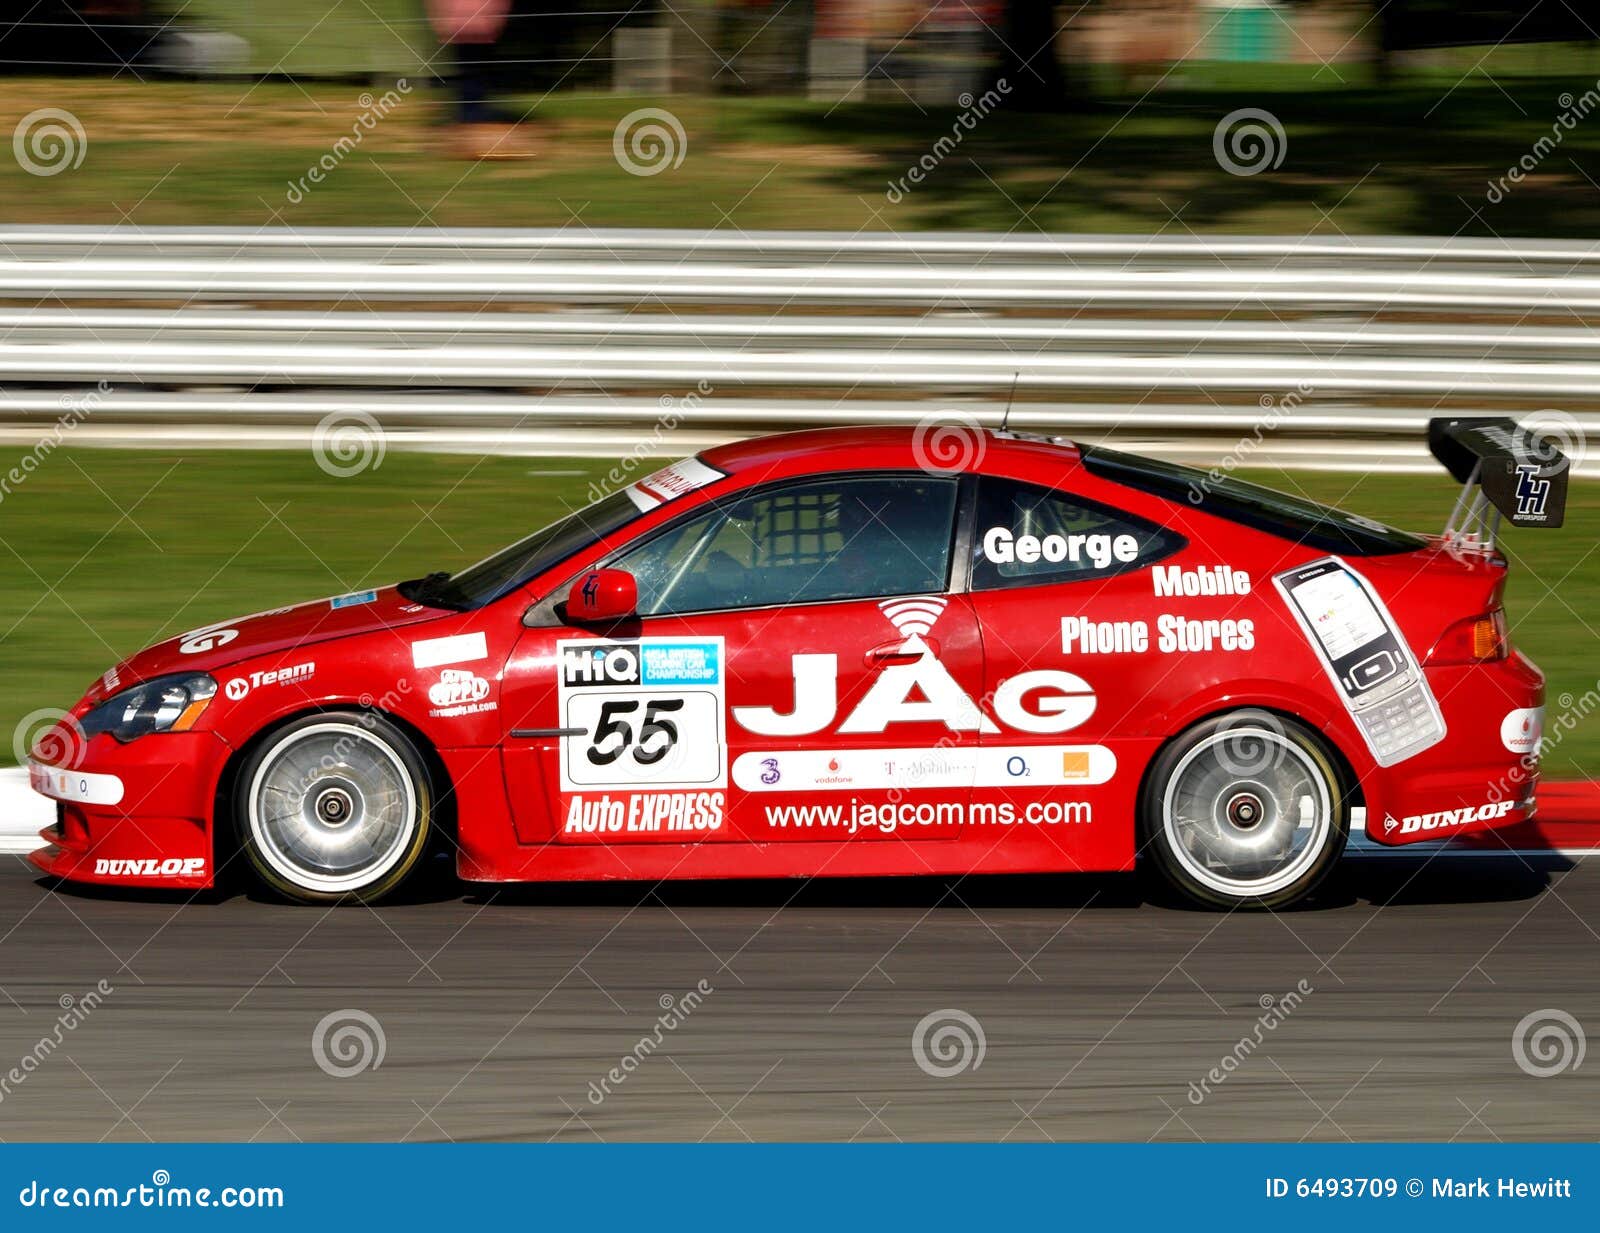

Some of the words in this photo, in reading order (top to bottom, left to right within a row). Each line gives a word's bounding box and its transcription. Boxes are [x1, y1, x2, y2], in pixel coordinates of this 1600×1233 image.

[983, 527, 1139, 568] George
[1151, 565, 1251, 597] Mobile
[1060, 616, 1149, 654] Phone
[1157, 614, 1255, 653] Stores
[250, 661, 315, 689] Team
[564, 648, 638, 682] HiQ
[731, 631, 1098, 737] JAG
[586, 698, 684, 765] 55
[564, 795, 625, 833] Auto
[626, 791, 725, 832] EXPRESS
[764, 798, 1093, 834] www.jagcomms.com
[1399, 800, 1515, 834] DUNLOP
[94, 858, 205, 877] DUNLOP
